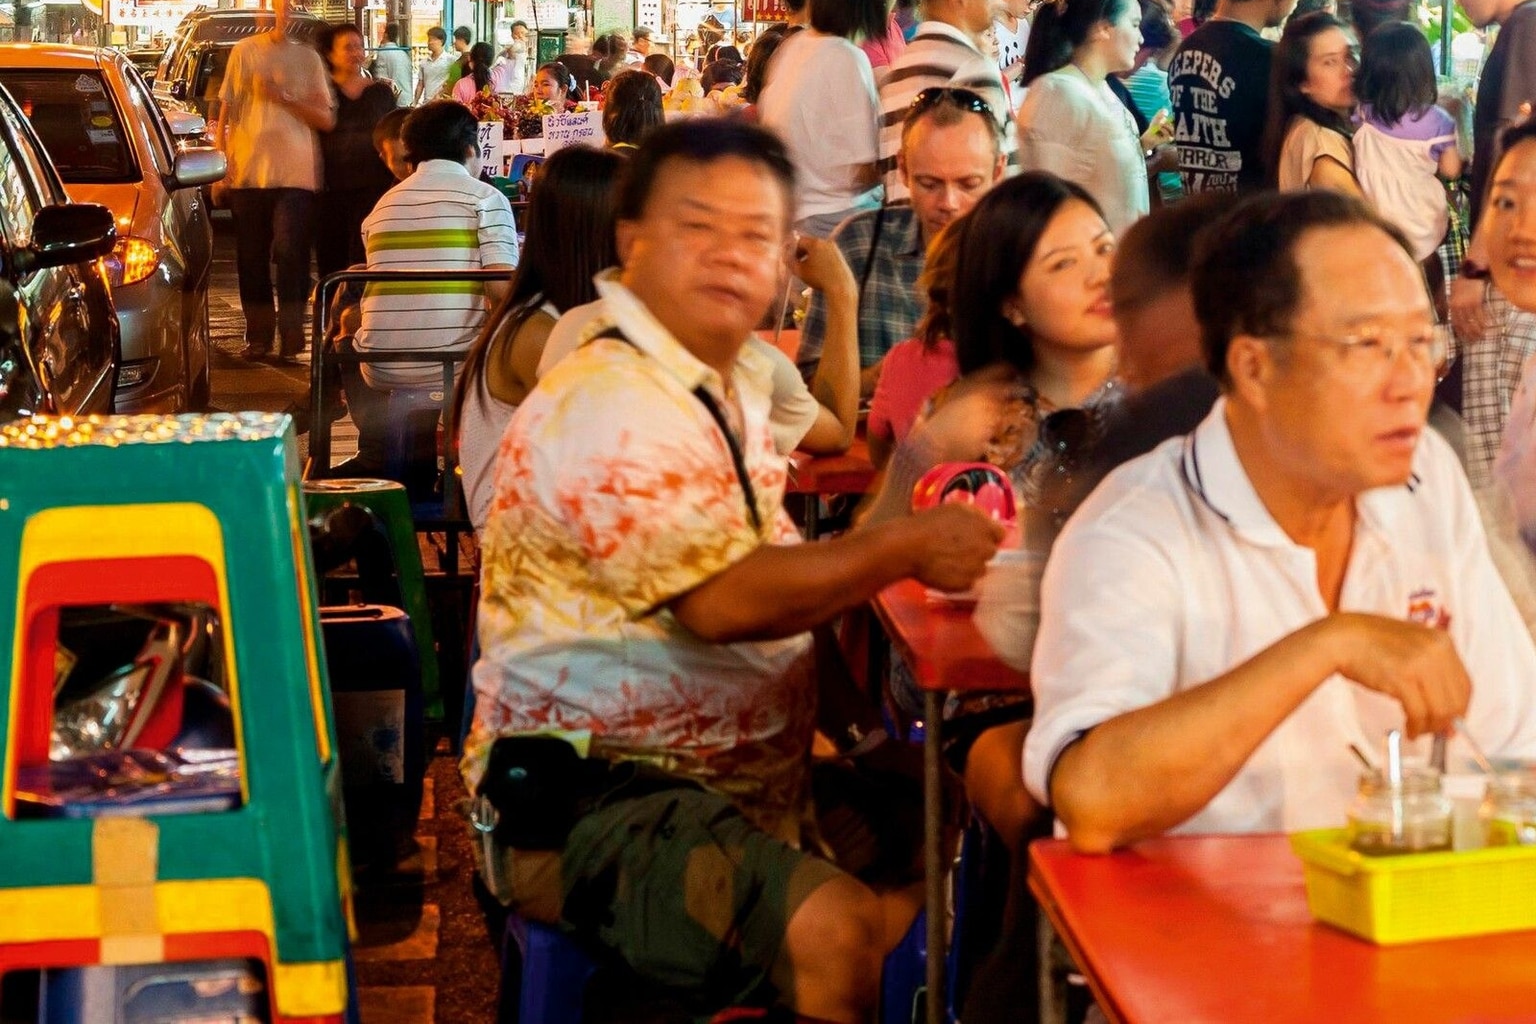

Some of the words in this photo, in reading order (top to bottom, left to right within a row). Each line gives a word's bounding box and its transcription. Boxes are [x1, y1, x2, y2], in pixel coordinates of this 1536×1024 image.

[1170, 49, 1236, 99] EEPERS
[1190, 86, 1218, 114] THE
[1174, 111, 1231, 148] AITH
